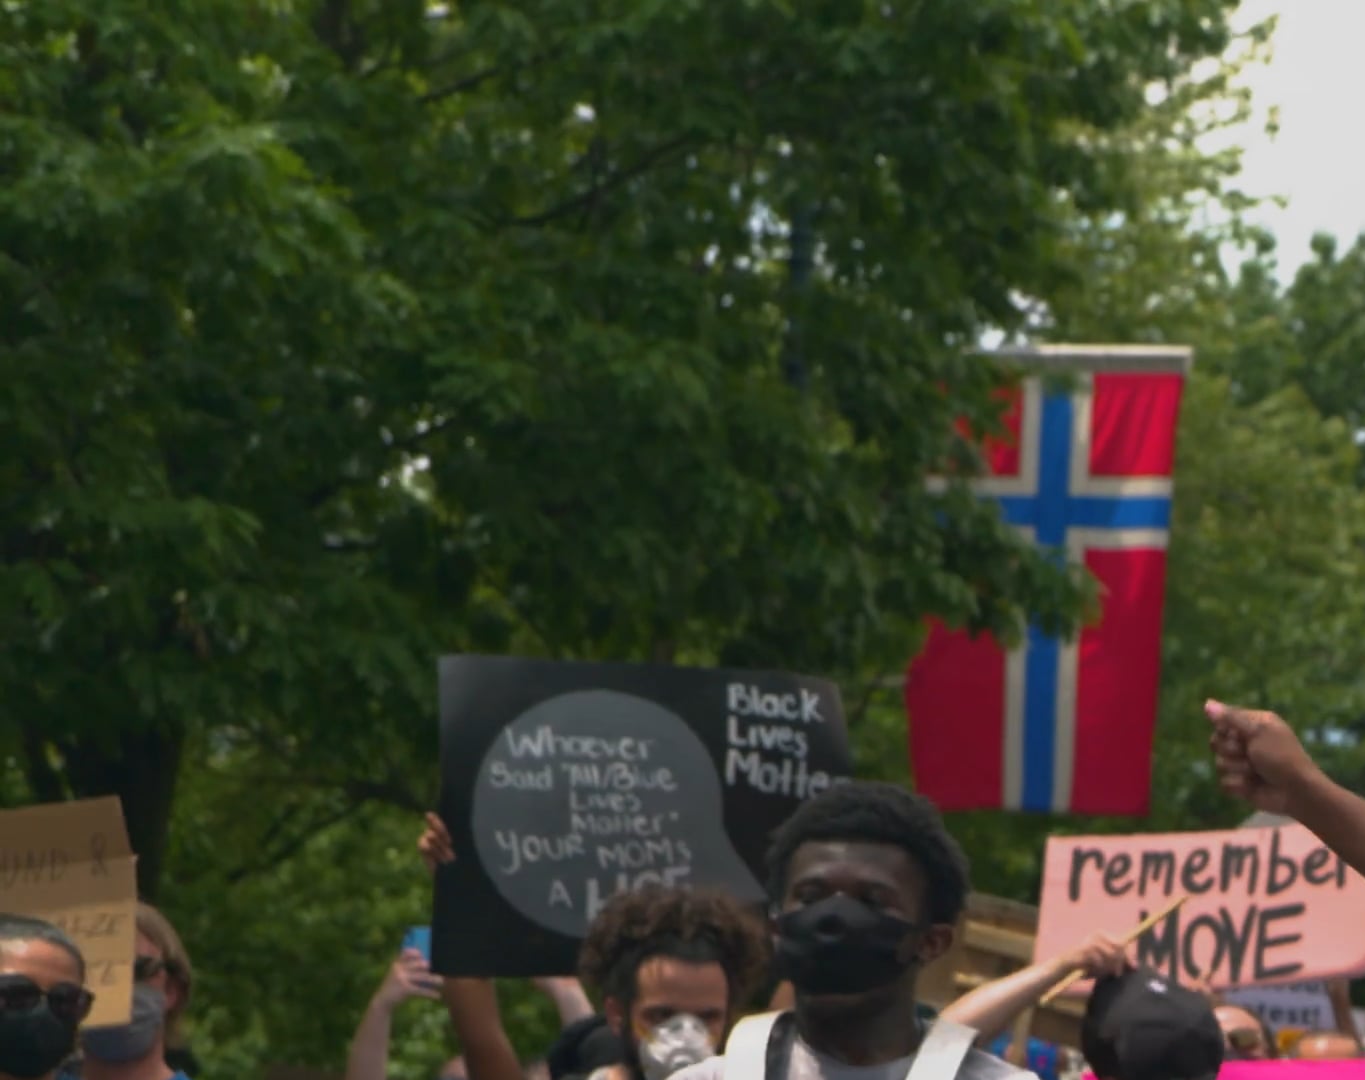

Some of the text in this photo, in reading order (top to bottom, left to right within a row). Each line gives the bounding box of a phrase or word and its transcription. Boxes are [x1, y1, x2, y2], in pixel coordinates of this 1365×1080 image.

[727, 682, 823, 723] Black
[727, 716, 808, 753] Lives
[489, 762, 553, 791] Said
[1137, 902, 1306, 984] MOVE
